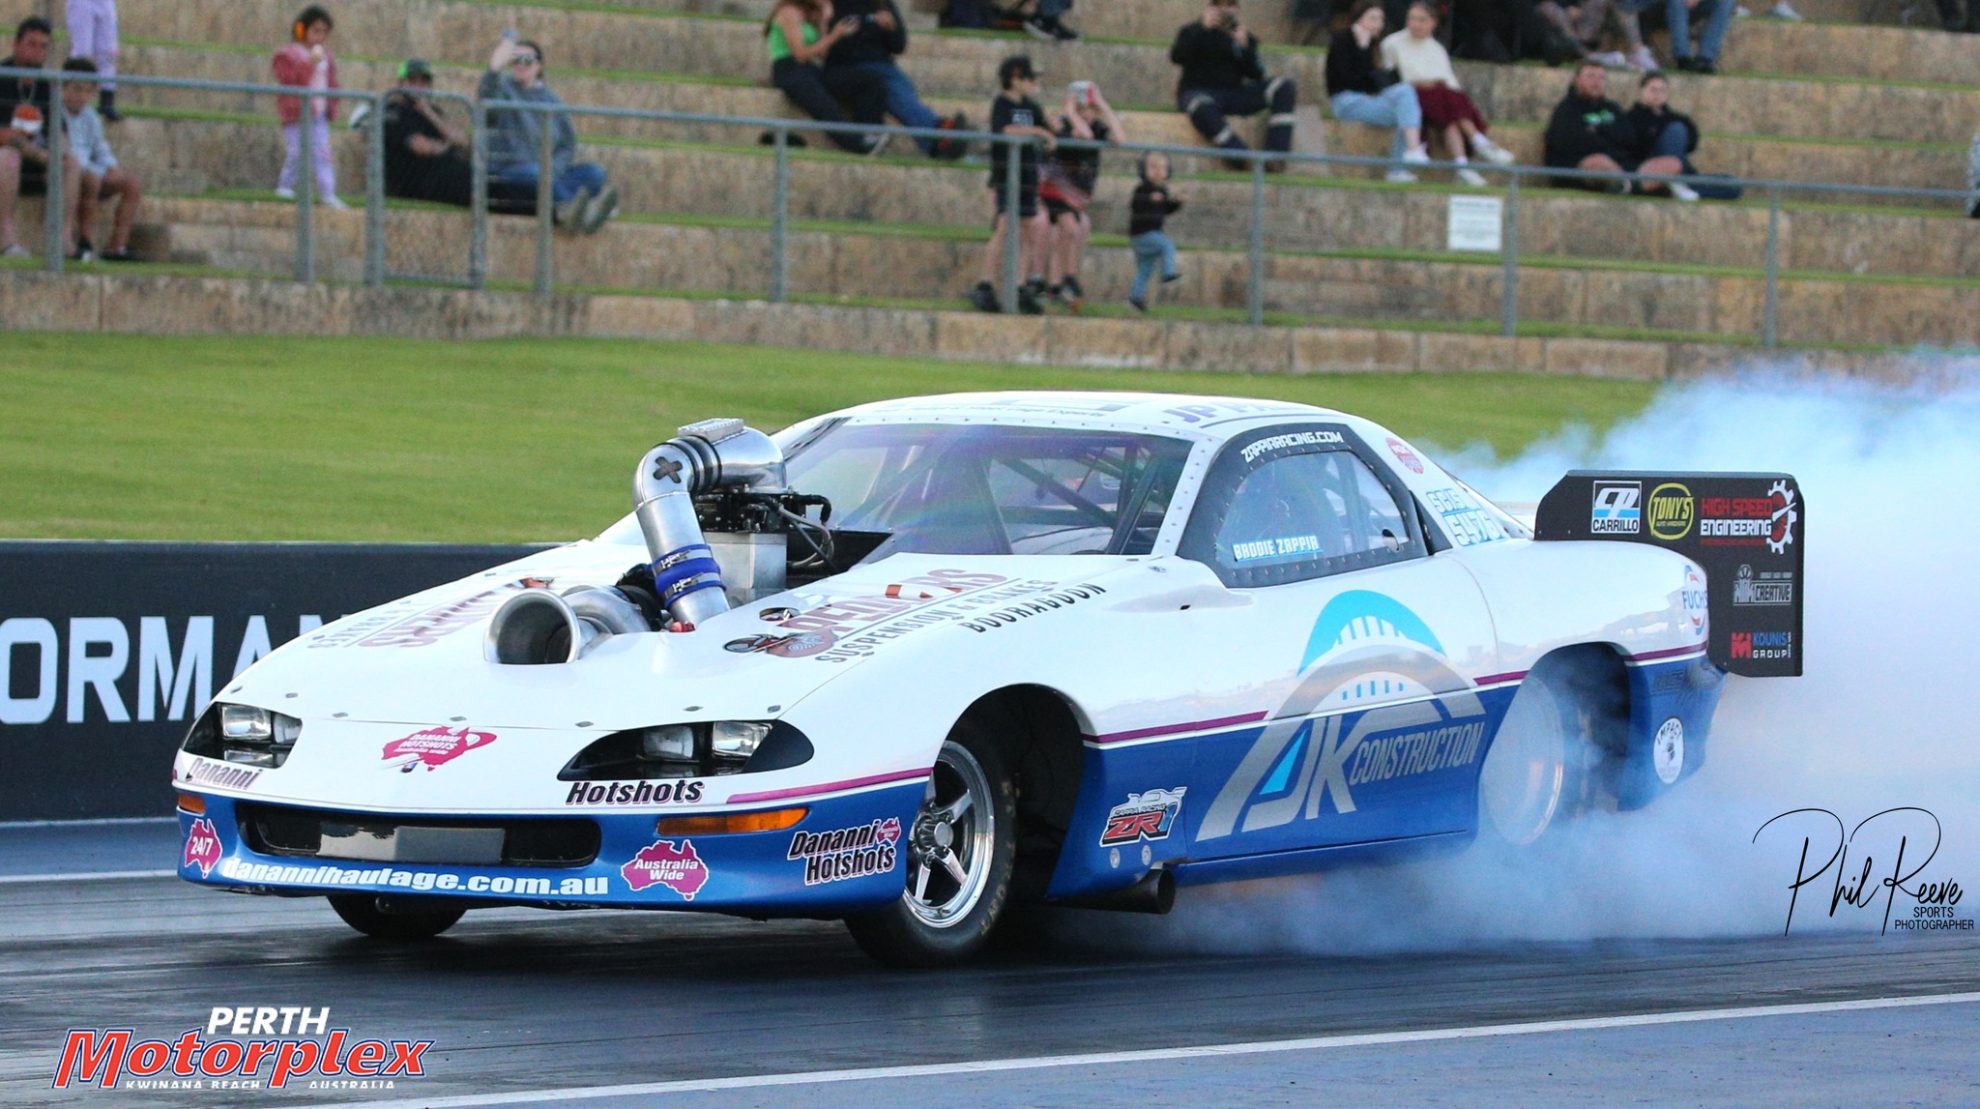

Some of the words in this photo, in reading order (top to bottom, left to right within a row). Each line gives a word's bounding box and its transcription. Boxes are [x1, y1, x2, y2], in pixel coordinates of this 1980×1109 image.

[1240, 431, 1344, 463] ZAPPIARACING.COM
[1702, 498, 1729, 516] HIGH
[1731, 498, 1772, 516] SPEED
[1592, 519, 1639, 532] CARRILLO
[1700, 519, 1772, 536] ENGINEERING
[1233, 540, 1276, 560] BRODIE
[1276, 535, 1319, 554] ZAPPIA
[1756, 583, 1792, 602] CREATIVE
[958, 583, 1107, 632] BOORAGOON
[815, 608, 955, 664] SUSPENSION
[1753, 649, 1787, 659] GROUP
[1350, 721, 1486, 786] CONSTRUCTION
[189, 757, 263, 790] Dananni
[565, 779, 704, 806] Hotshots
[1102, 804, 1178, 842] ZR1
[191, 836, 212, 857] 24/7
[788, 819, 881, 859] Dananni
[222, 857, 609, 895] danannihaulage.com.au
[633, 857, 699, 870] Australia
[649, 869, 685, 882] Wide
[805, 845, 896, 885] Hotshots
